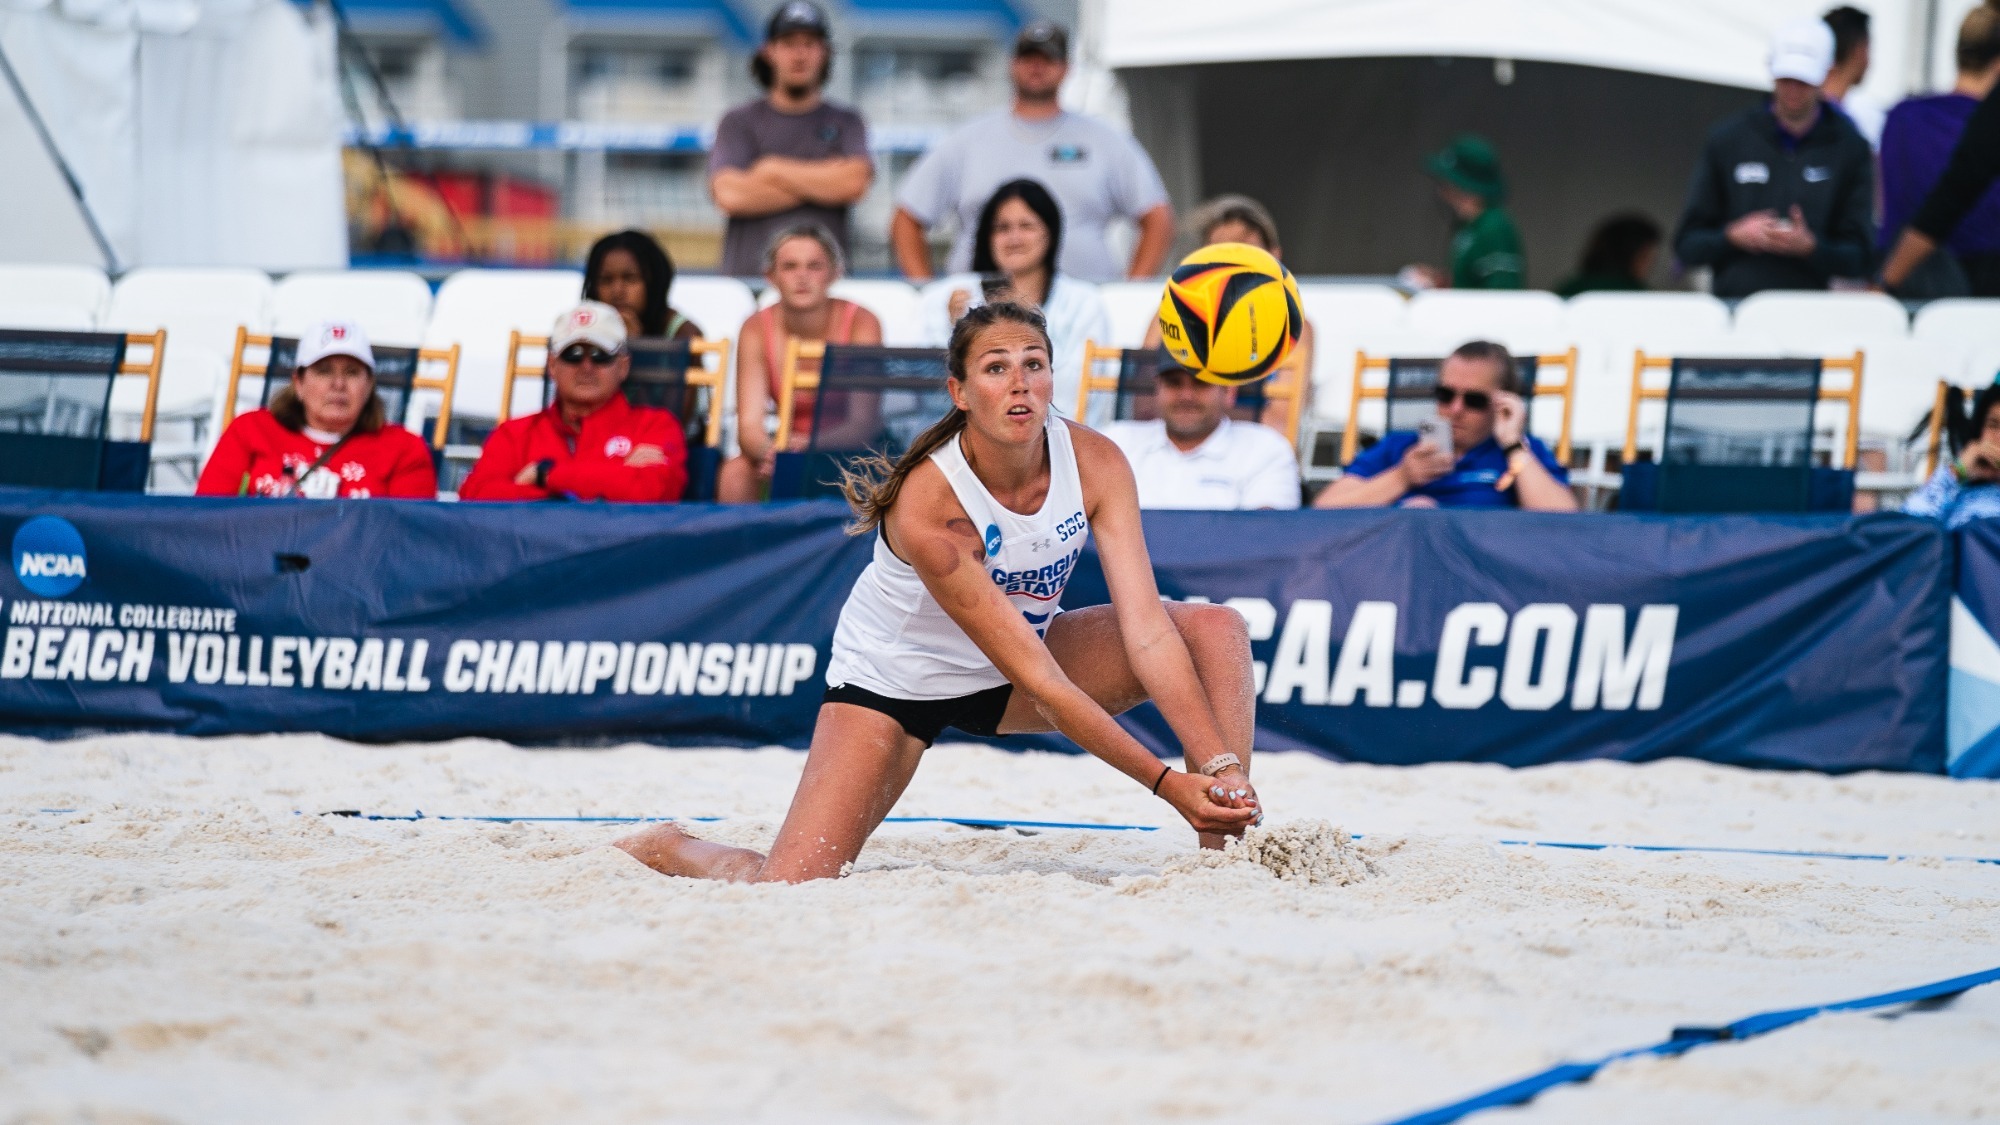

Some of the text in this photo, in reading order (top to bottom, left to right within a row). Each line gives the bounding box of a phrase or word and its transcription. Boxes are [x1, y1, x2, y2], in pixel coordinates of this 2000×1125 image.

[1056, 511, 1085, 542] SBC
[20, 552, 86, 578] NCAA
[991, 548, 1079, 586] GEORGIA
[1006, 569, 1069, 597] STATE
[10, 600, 237, 632] NATIONAL COLLEGIATE
[0, 626, 818, 696] BEACH VOLLEYBALL CHAMPIONSHIP
[1159, 595, 1680, 711] CAA.COM
